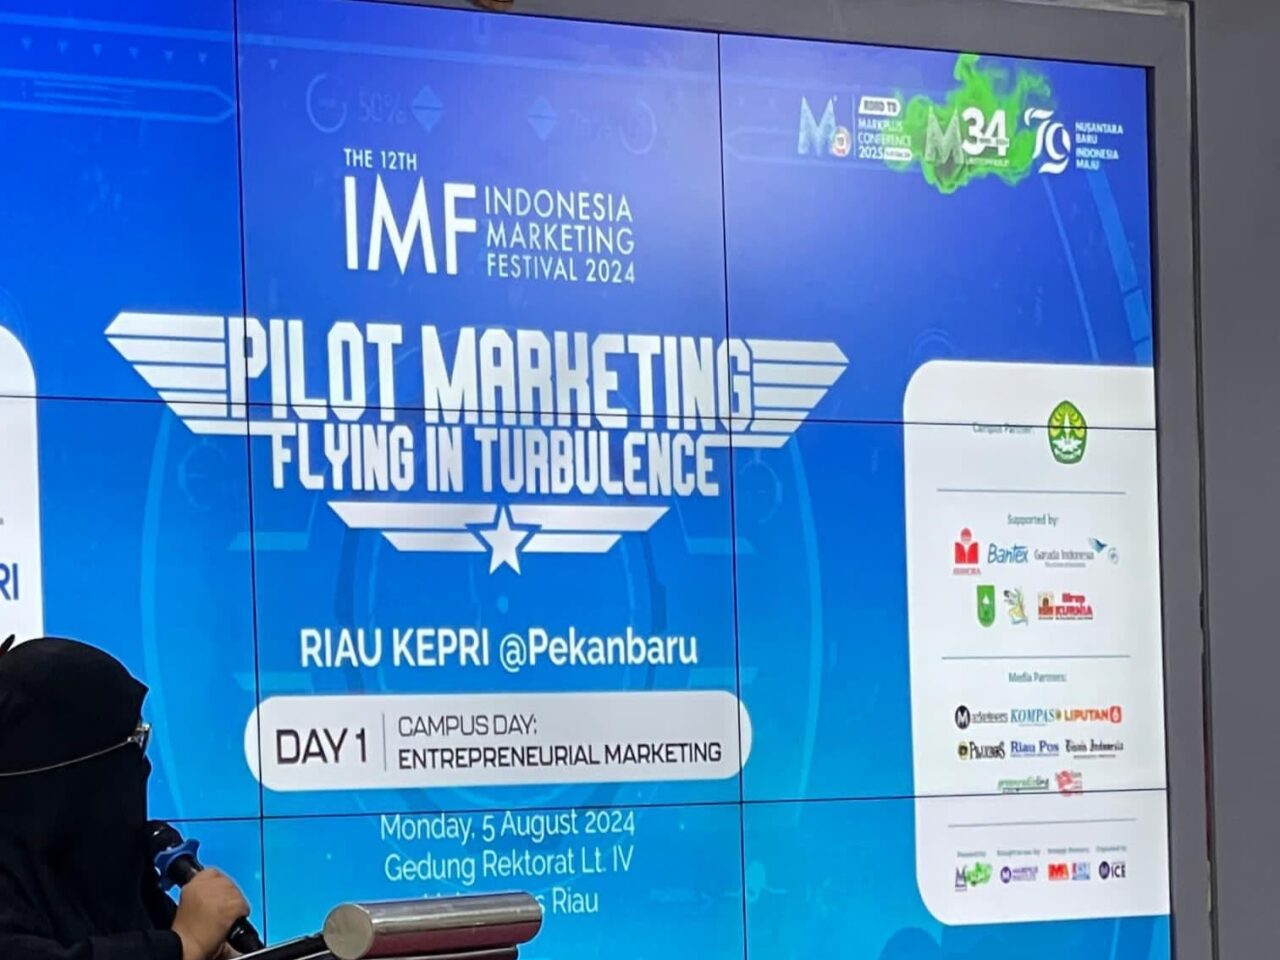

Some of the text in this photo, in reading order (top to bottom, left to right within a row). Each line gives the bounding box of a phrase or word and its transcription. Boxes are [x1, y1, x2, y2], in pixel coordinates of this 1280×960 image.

[1075, 121, 1124, 135] NUSANTARA
[1075, 133, 1098, 144] BARU
[343, 147, 418, 171] THE 12TH
[859, 145, 884, 159] 2025
[1075, 147, 1120, 160] INDONESIA
[1075, 159, 1100, 171] MAJU
[484, 185, 633, 223] INDONESIA
[344, 173, 477, 276] IMF
[486, 218, 635, 255] MARKETING
[486, 253, 636, 284] FESTIVAL 2024
[225, 316, 754, 432] PILOT MARKETING
[269, 422, 721, 498] FLYING IN TURBULENCE
[1007, 513, 1046, 526] Supported
[987, 543, 1029, 564] Bantex
[1055, 605, 1093, 617] KURNIA
[300, 625, 698, 673] RIAU KEPRI @Pekanbaru
[1008, 672, 1033, 683] Media
[398, 713, 538, 737] CAMPUS DAY:
[1010, 707, 1056, 723] KOMPAS
[276, 727, 368, 765] DAY 1
[399, 741, 722, 771] ENTREPRENEURIAL MARKETING
[1010, 740, 1036, 753] Riau
[1038, 739, 1060, 752] Pos
[380, 809, 636, 846] Monday, 5 August 2024
[384, 845, 634, 886] Gedung Rektorat Lt. IV
[553, 888, 599, 915] Riau
